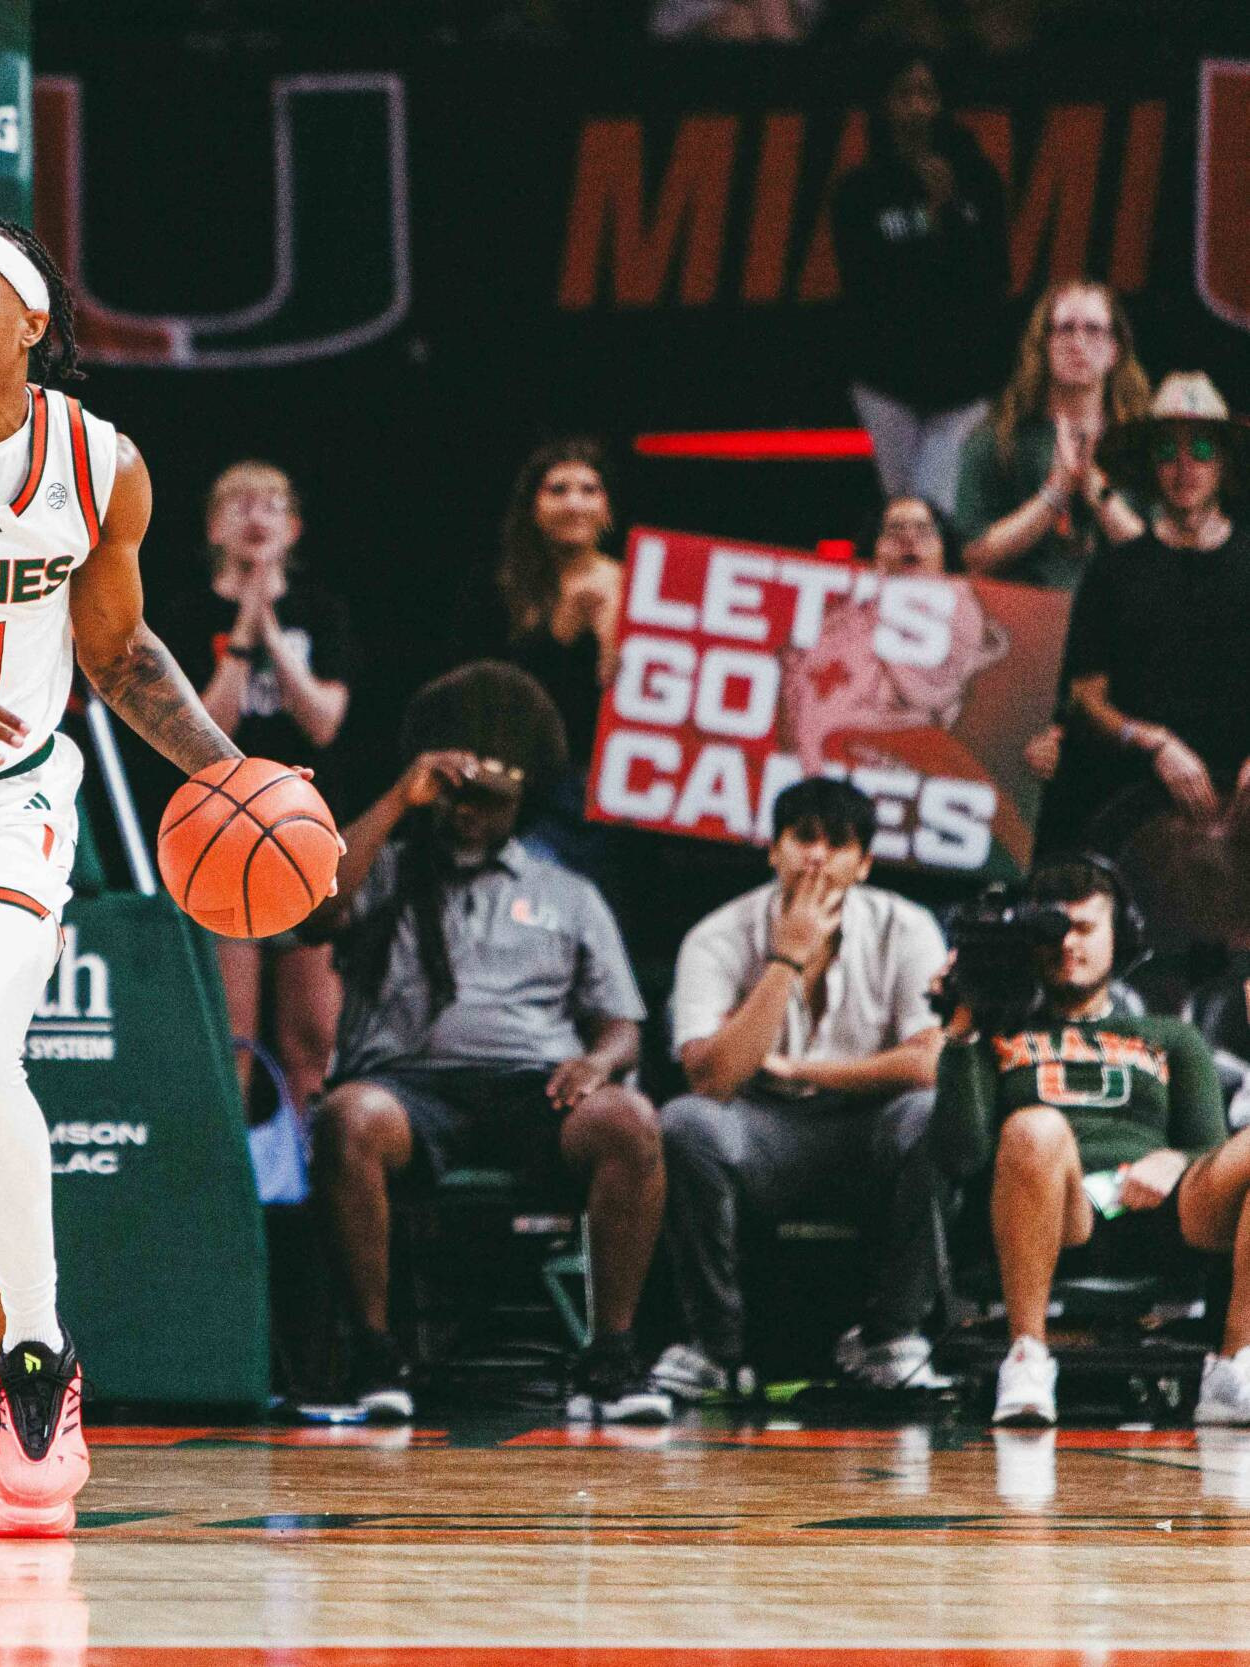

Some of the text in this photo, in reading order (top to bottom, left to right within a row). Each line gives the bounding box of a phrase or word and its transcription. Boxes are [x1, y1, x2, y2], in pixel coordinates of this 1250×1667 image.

[628, 535, 956, 668] LET'S
[613, 632, 780, 739] GO
[27, 1035, 114, 1061] SYSTEM
[1035, 1063, 1133, 1108] U
